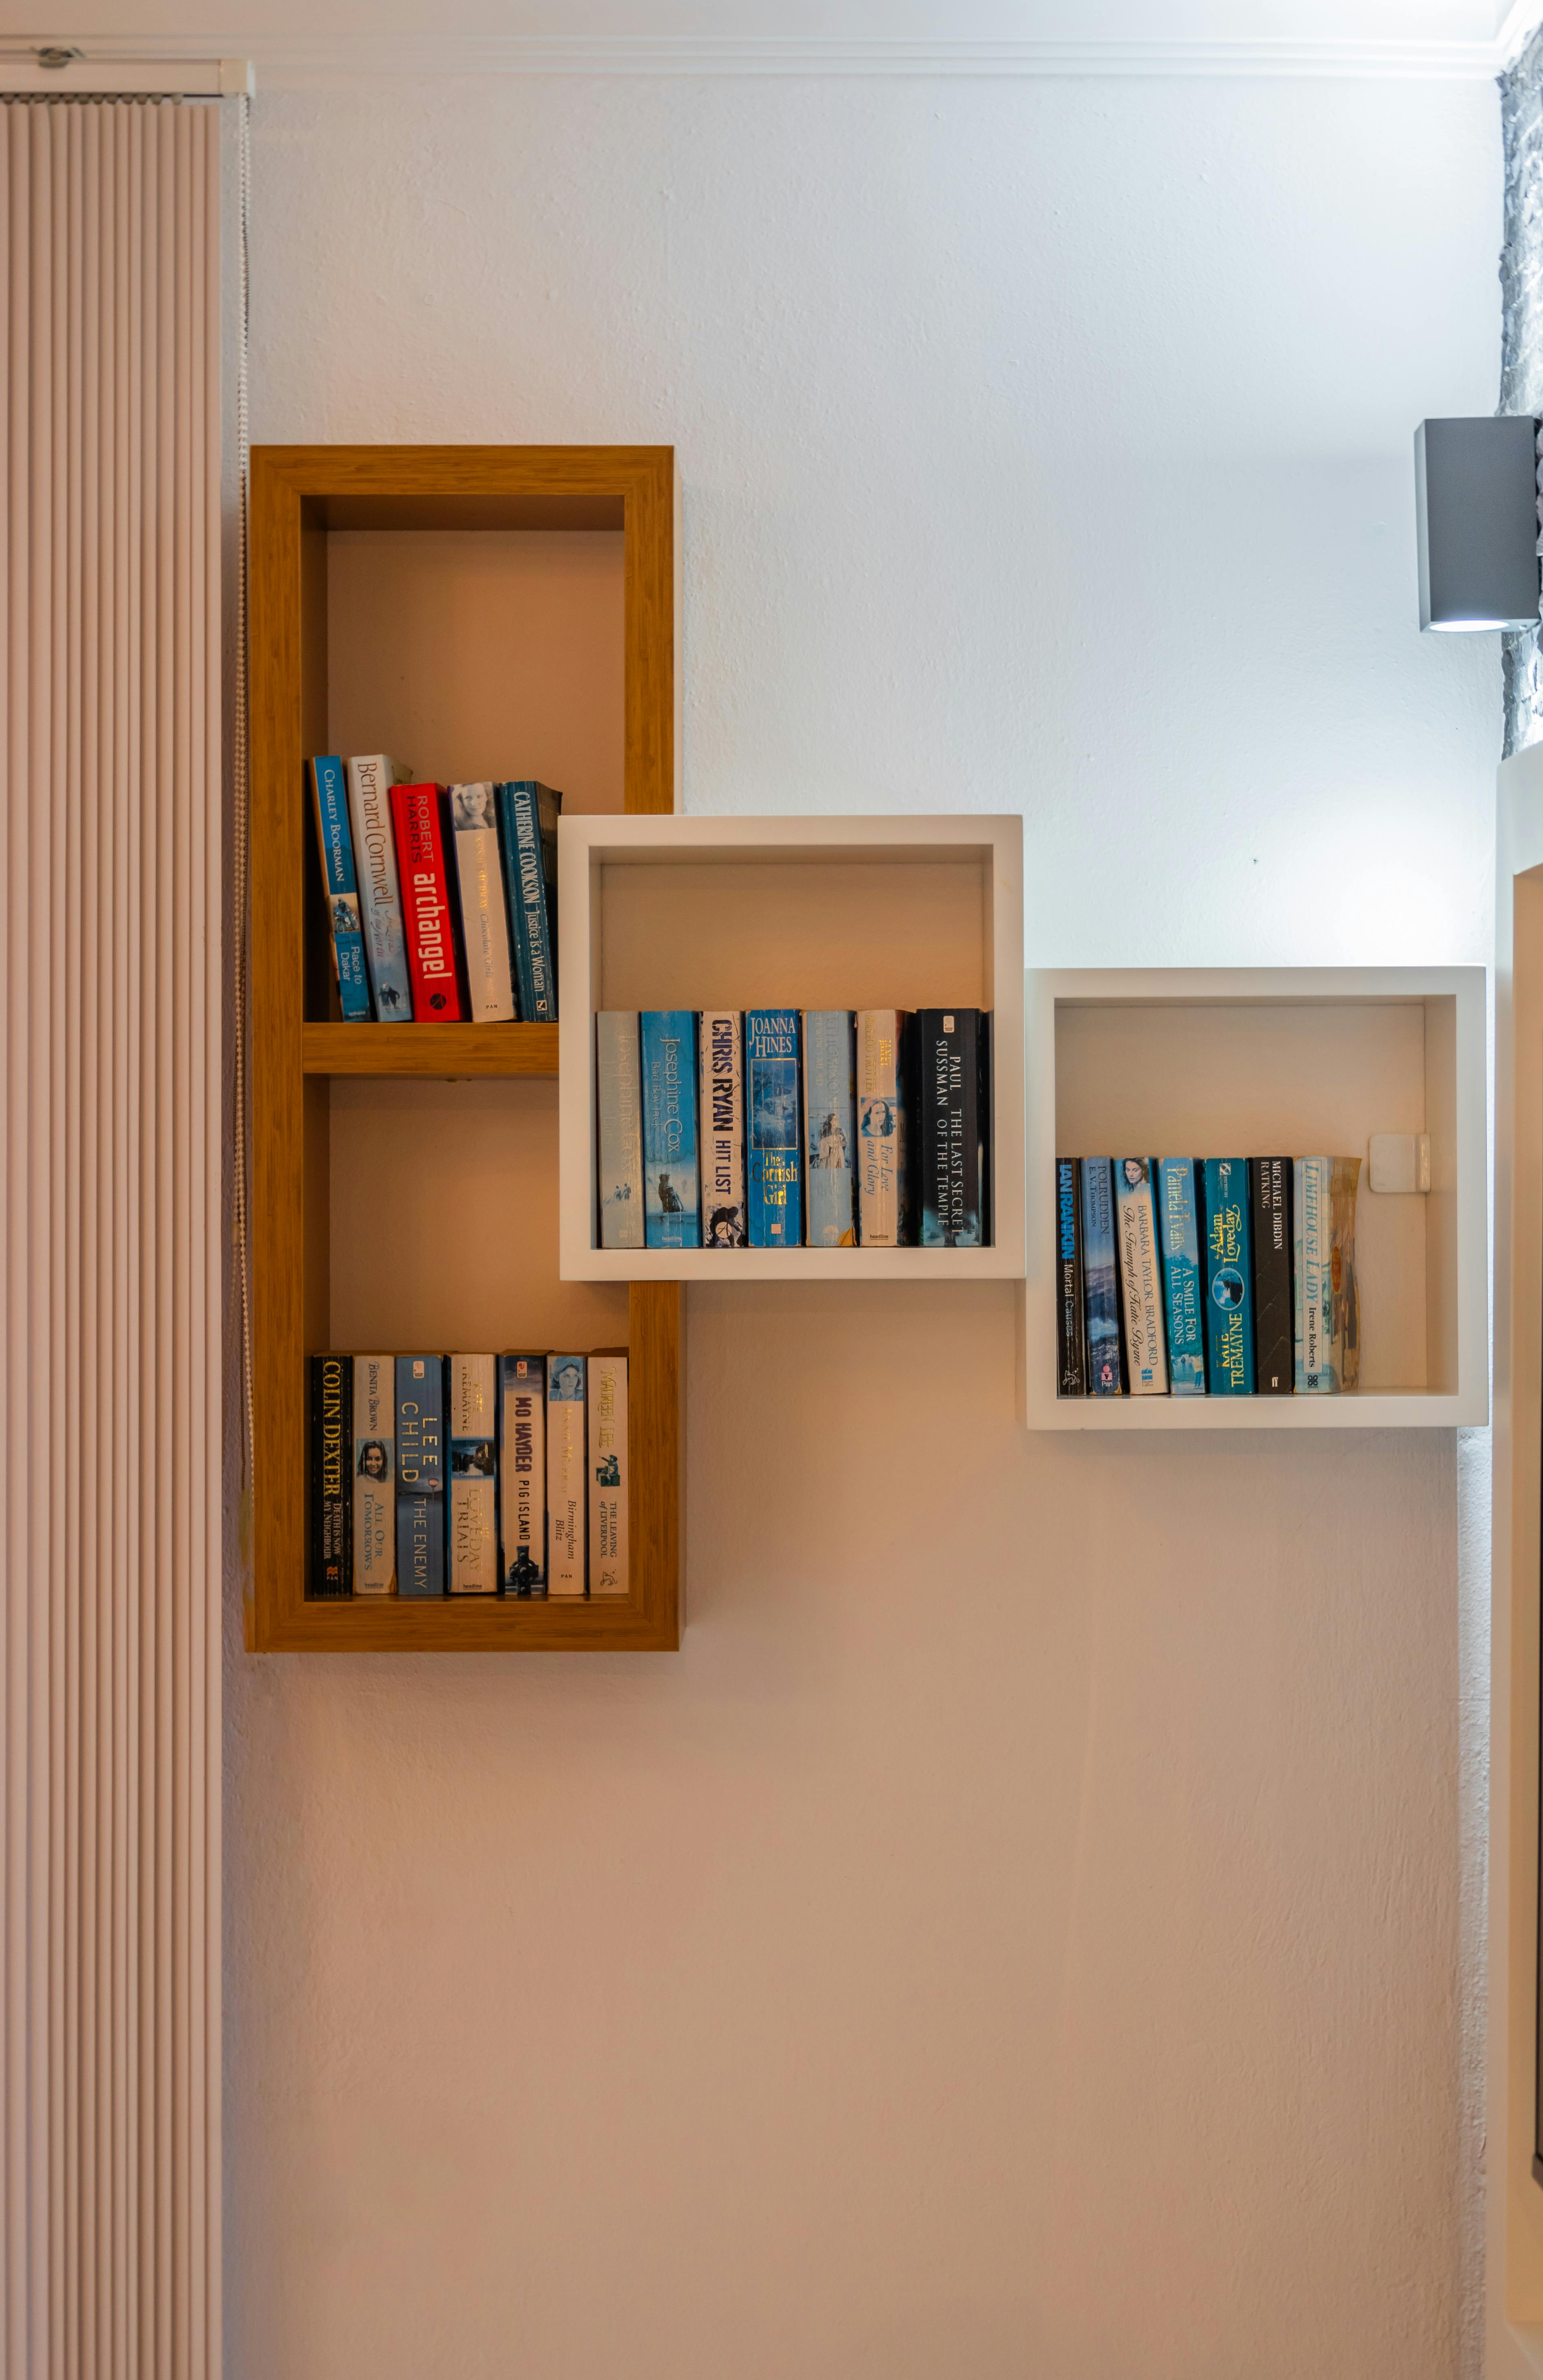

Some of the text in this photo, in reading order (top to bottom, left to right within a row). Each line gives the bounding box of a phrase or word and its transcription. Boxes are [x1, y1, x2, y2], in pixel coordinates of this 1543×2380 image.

[324, 769, 344, 882] CHARLEY BOORMAN
[357, 761, 393, 907] Bernard Cornwell
[407, 796, 422, 863] HARRIS
[417, 795, 434, 862] ROBERT
[514, 792, 540, 903] CATHERINE COOKSON
[414, 873, 452, 979] archangel
[480, 914, 493, 978] Chocolate Girls
[524, 907, 540, 939] Justice
[531, 940, 538, 949] is
[341, 952, 350, 981] Dakar
[351, 946, 362, 984] Race to
[531, 955, 545, 992] Woman
[749, 1018, 796, 1046] JOANNA
[755, 1037, 792, 1057] HINES
[879, 1039, 891, 1067] JANET
[612, 1035, 638, 1128] Josephine
[651, 1061, 662, 1129] Bad Boy Jack
[659, 1037, 683, 1153] Josephine Cox
[711, 1019, 733, 1132] CHRIS RYAN
[865, 1055, 877, 1092] TROTTER
[936, 1040, 948, 1105] SUSSMAN
[950, 1056, 961, 1090] PAUL
[715, 1140, 731, 1194] HIT LIST
[753, 1162, 798, 1182] Cornish
[764, 1152, 780, 1166] The
[864, 1140, 879, 1195] and Glory
[881, 1144, 893, 1192] For Love
[937, 1119, 948, 1226] OF THE TEMPLE
[951, 1109, 964, 1234] THE LAST SECRET
[1090, 1176, 1096, 1184] V.
[1261, 1162, 1270, 1208] RATKING
[764, 1184, 787, 1205] Girl
[1059, 1164, 1074, 1259] IAN RANKIN
[1098, 1166, 1109, 1234] POLRUDDEN
[1167, 1164, 1190, 1250] Pamela Evans
[1272, 1161, 1282, 1250] MICHAEL DIBDIN
[1210, 1213, 1224, 1259] Adam
[1224, 1205, 1242, 1263] Loveday
[1305, 1163, 1319, 1304] LIMEHOUSE LADY
[1064, 1264, 1074, 1336] Mortal Causes
[1123, 1205, 1144, 1366] The Triumph of Katie Byrne
[1138, 1205, 1158, 1365] BARBARA TAYLOR BRADFORD
[1171, 1266, 1184, 1344] ALL SEASONS
[1182, 1268, 1196, 1341] A SMILE FOR
[1216, 1333, 1229, 1368] KATE
[1229, 1313, 1244, 1387] TREMAYNE
[323, 1361, 341, 1496] COLIN DEXTER
[369, 1362, 380, 1431] BENITA BROWN
[462, 1365, 472, 1431] TREMAYNE
[515, 1397, 532, 1417] MO
[598, 1366, 617, 1448] MAUREEN LEE
[401, 1402, 418, 1483] CHILD
[422, 1417, 438, 1466] LEE
[515, 1423, 533, 1473] HAYDER
[324, 1500, 333, 1559] MY NEIGHBOUR
[333, 1503, 342, 1528] DEATH
[365, 1493, 374, 1570] TOMORROWS
[375, 1502, 385, 1557] ALL OUR
[457, 1498, 469, 1562] TRIALS
[469, 1489, 482, 1574] LOVEDAY
[518, 1480, 530, 1540] PIG ISLAND
[556, 1519, 564, 1541] Blitz
[565, 1500, 577, 1559] Birmingham
[414, 1498, 427, 1588] THE ENEMY
